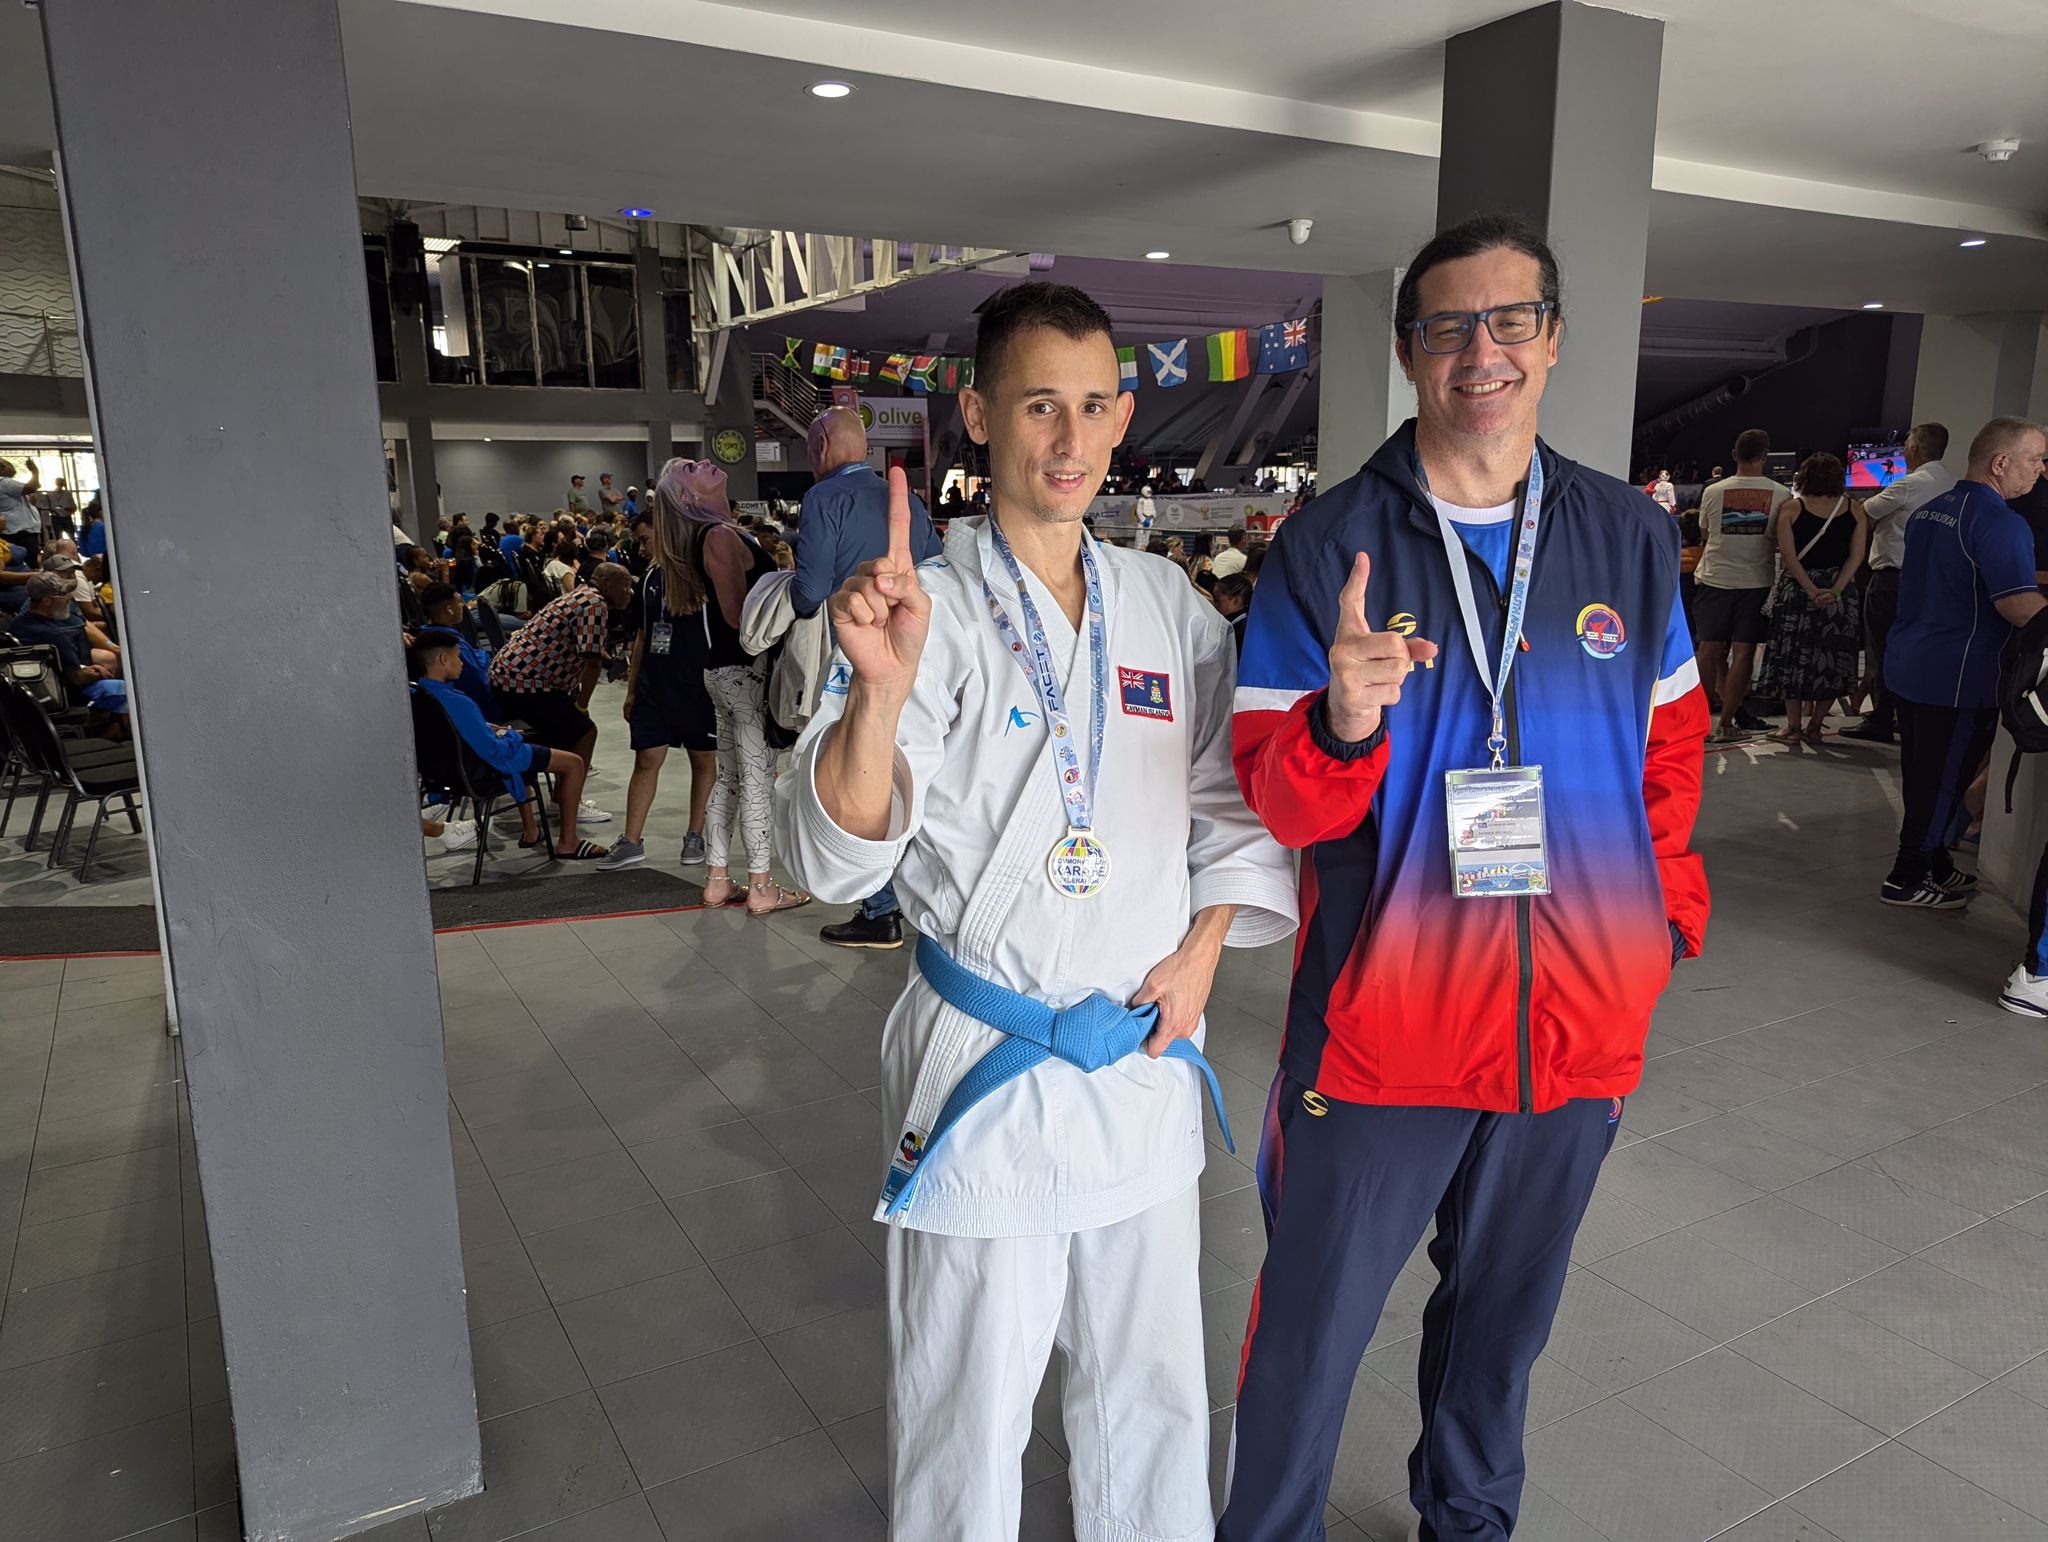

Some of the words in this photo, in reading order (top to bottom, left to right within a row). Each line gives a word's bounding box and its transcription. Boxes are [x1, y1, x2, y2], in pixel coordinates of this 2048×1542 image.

[878, 406, 922, 424] olive
[1036, 649, 1060, 712] FACET
[1125, 704, 1148, 714] CAYMAN
[904, 1138, 919, 1152] WKF
